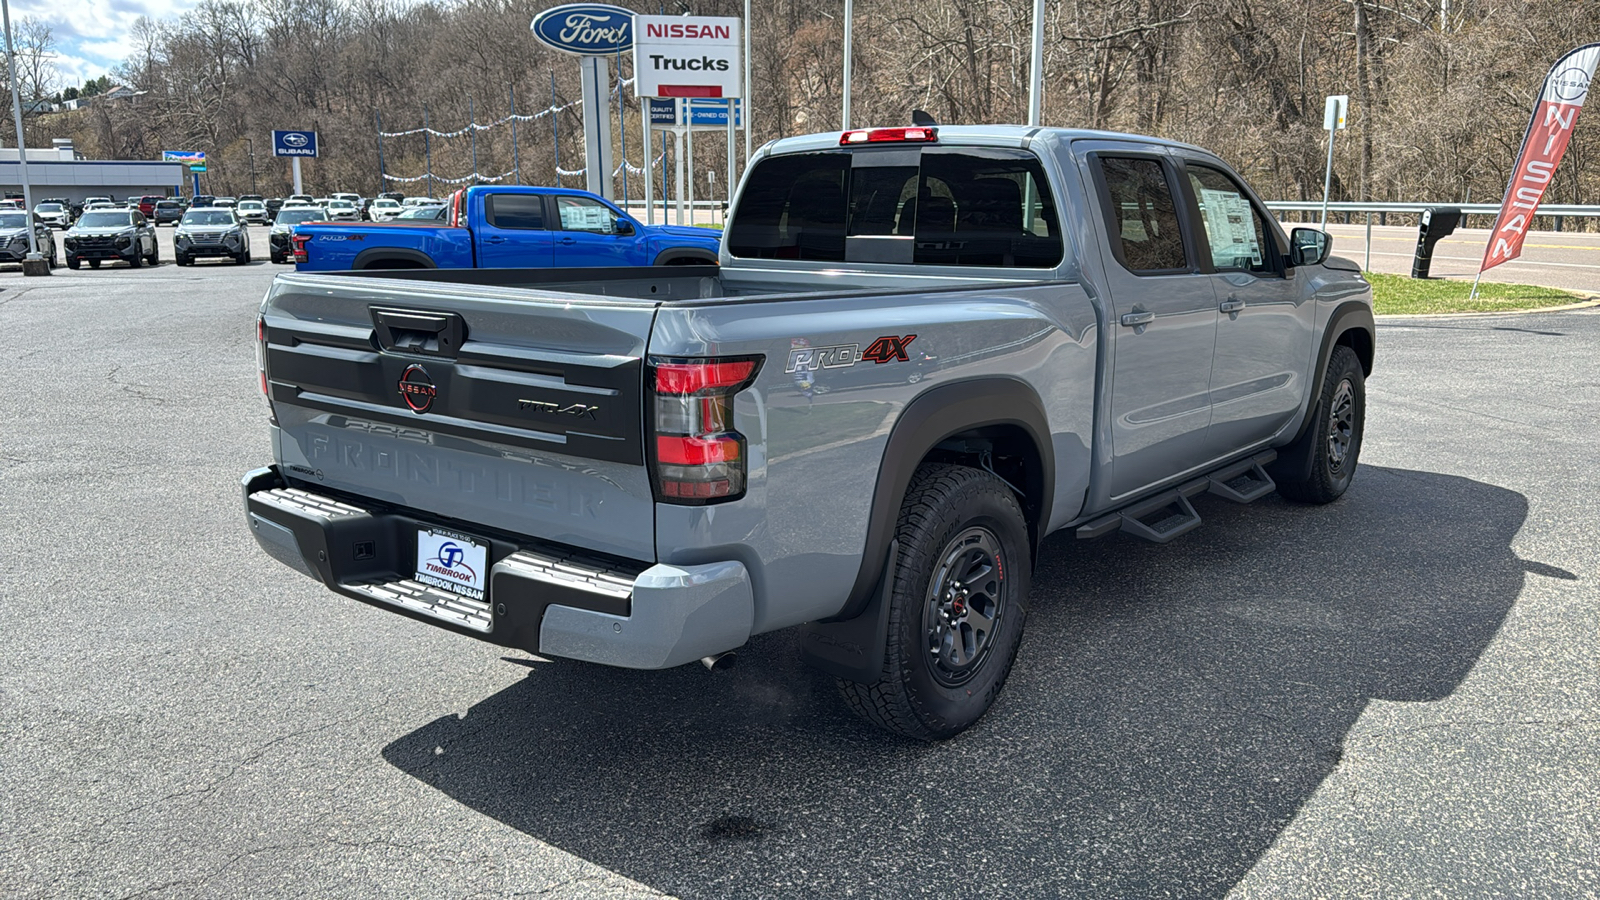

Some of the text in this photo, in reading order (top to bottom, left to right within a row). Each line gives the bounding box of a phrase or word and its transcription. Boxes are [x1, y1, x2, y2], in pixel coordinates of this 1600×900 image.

[559, 13, 628, 44] Ford
[647, 23, 730, 39] NISSAN
[649, 55, 729, 71] Trucks
[1551, 78, 1590, 90] NISSAN
[683, 111, 717, 119] PE-OWNED
[1491, 105, 1575, 259] NISSAN
[399, 382, 436, 396] NISSAN
[289, 465, 316, 476] TIMBROOK
[305, 430, 603, 518] FRONTIER
[425, 562, 472, 582] TIMBROOK
[414, 572, 484, 600] TIMBROOK NISSAN
